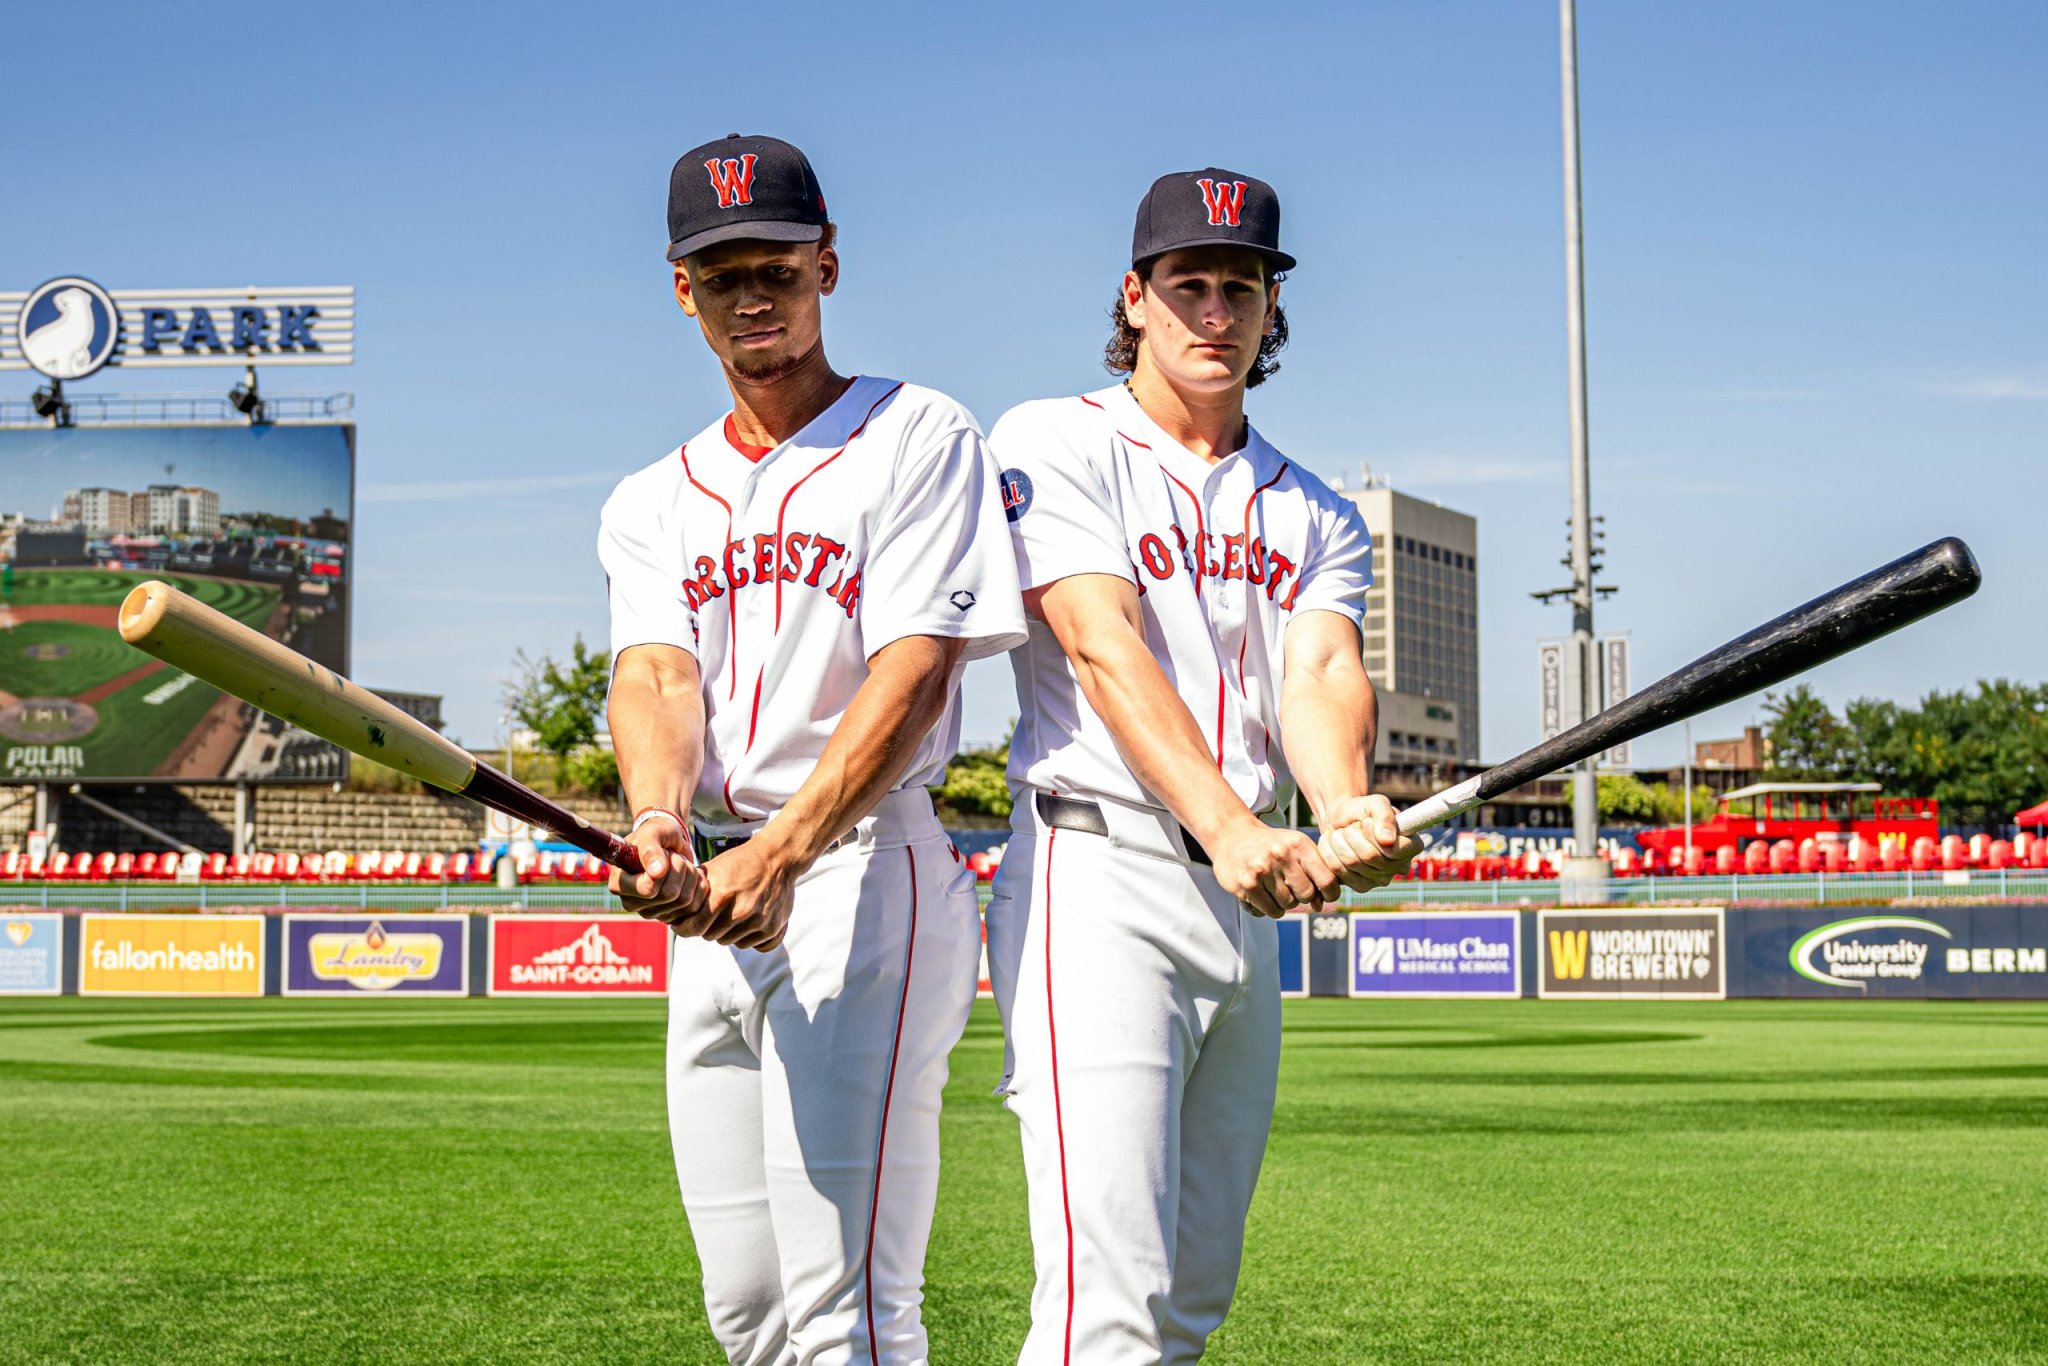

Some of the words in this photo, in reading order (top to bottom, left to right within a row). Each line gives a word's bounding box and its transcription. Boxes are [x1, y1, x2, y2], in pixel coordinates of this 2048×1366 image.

[704, 153, 758, 209] W
[1196, 178, 1248, 227] W
[140, 305, 321, 353] PARK
[6, 746, 84, 769] POLAR
[91, 940, 255, 971] fallonhealth
[326, 939, 425, 973] Landry
[1397, 937, 1458, 960] UMass
[1459, 936, 1510, 960] Chan
[1549, 930, 1588, 980] W
[1823, 939, 1928, 966] University
[1946, 948, 2047, 973] BERM
[510, 965, 653, 985] SAINT-GOBAIN
[1590, 955, 1692, 980] BREWERY
